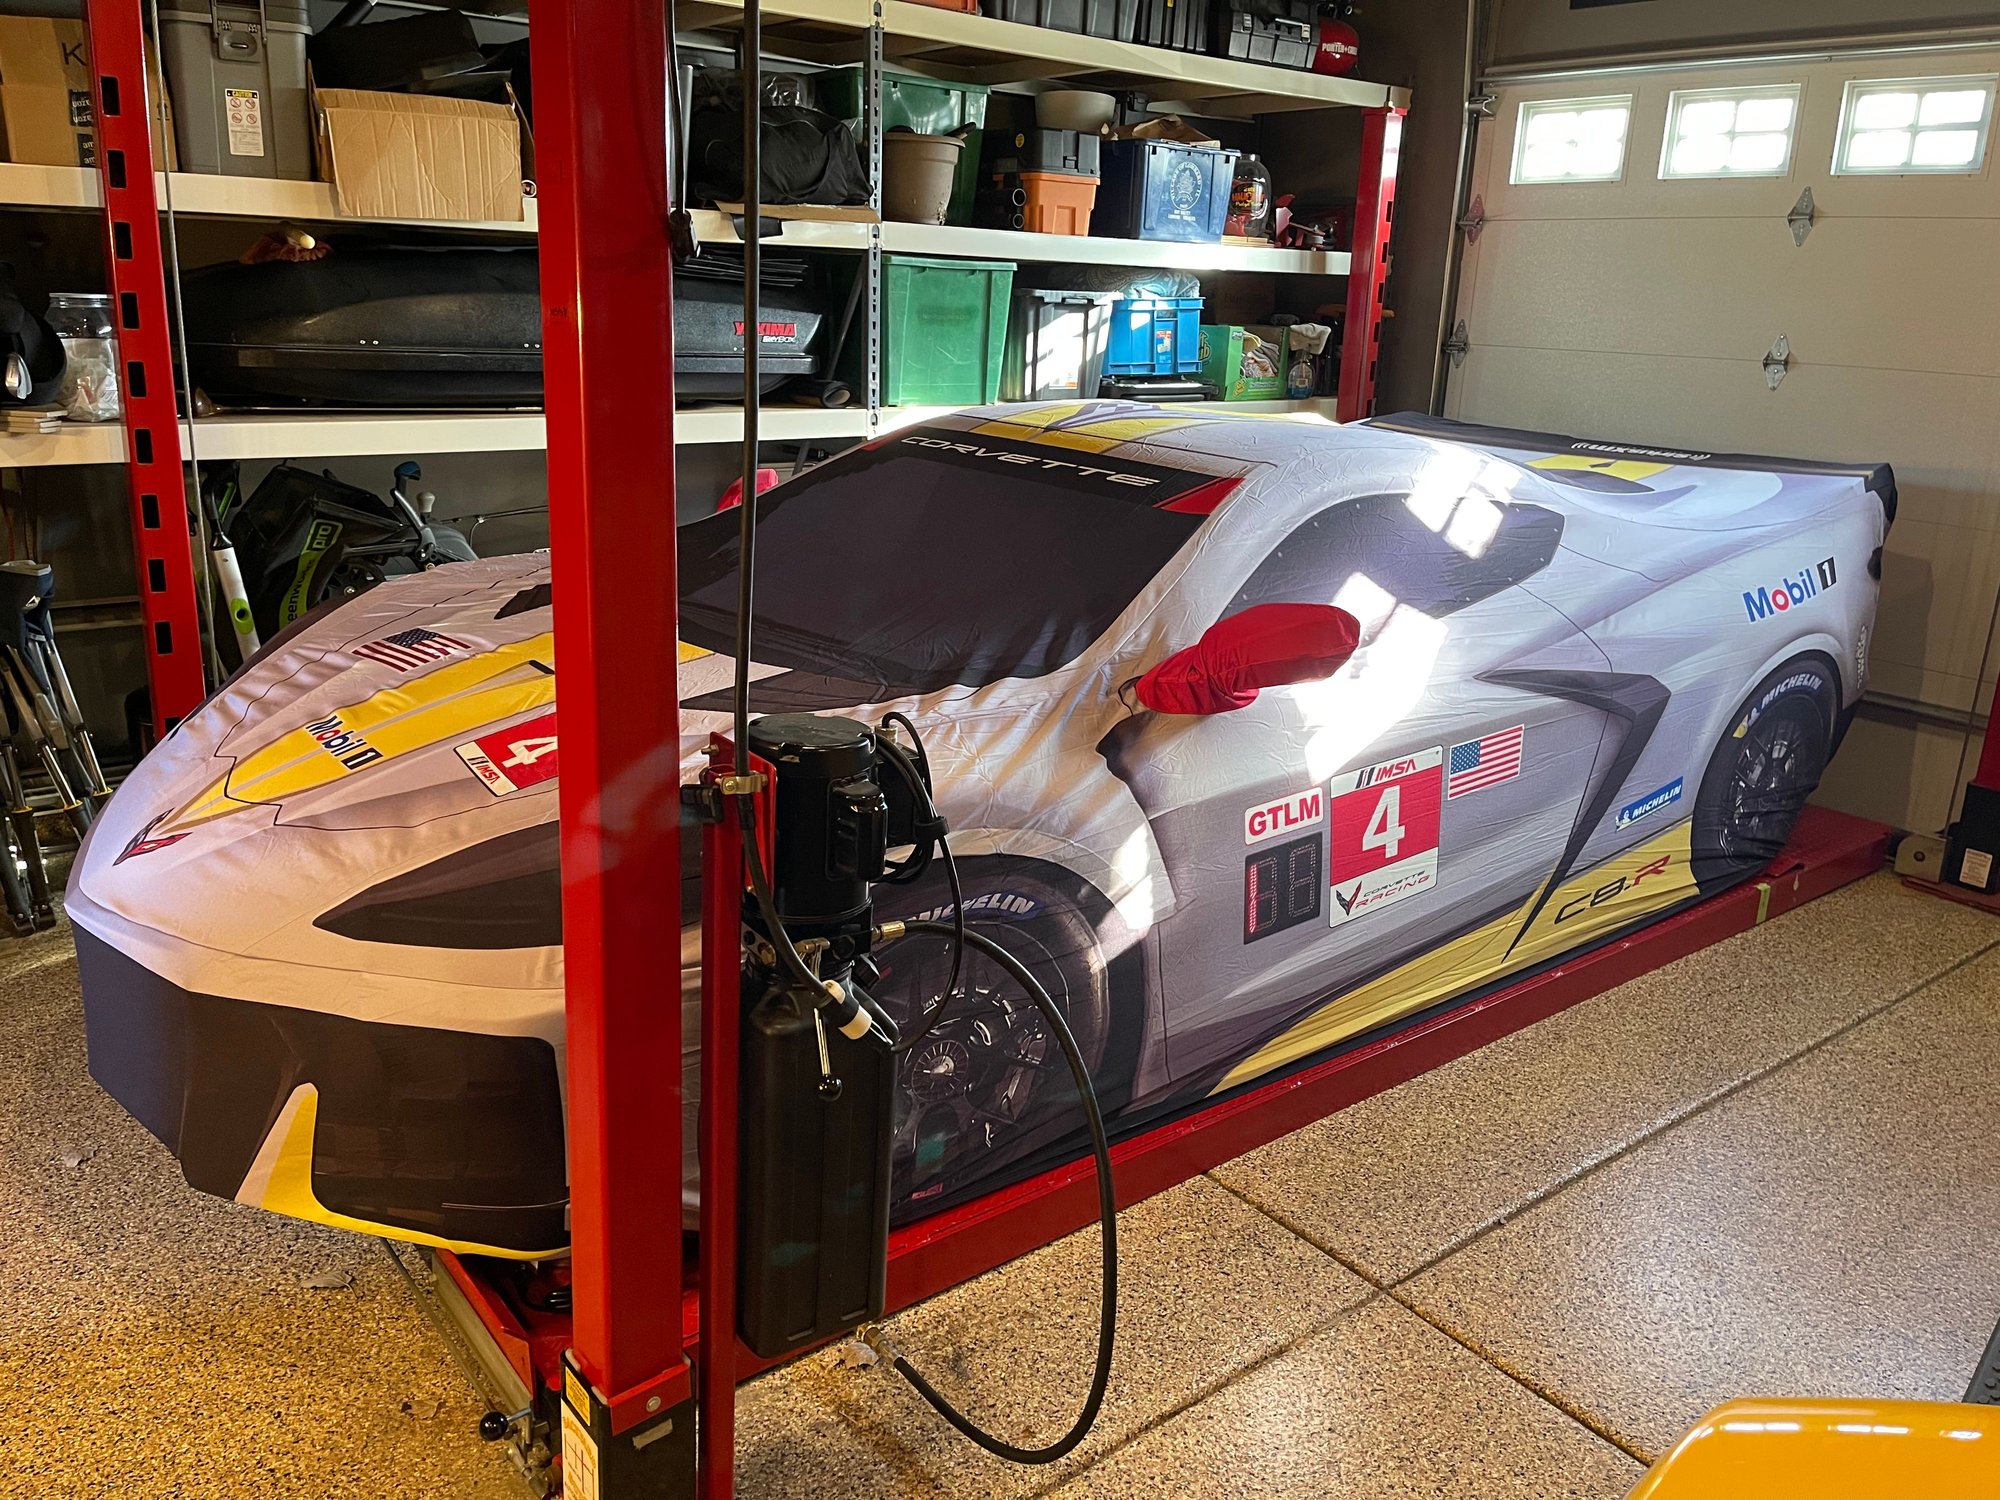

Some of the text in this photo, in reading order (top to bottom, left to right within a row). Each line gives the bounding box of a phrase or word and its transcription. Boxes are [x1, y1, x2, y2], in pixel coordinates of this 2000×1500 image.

[733, 321, 795, 337] YKIMA
[901, 436, 1160, 487] CORVETTE
[312, 525, 332, 549] pro
[287, 559, 314, 622] eenworks
[1742, 568, 1816, 623] Mobil
[1761, 673, 1823, 709] MICHELIN
[305, 715, 364, 757] Mobil
[501, 735, 558, 768] 4
[1374, 759, 1417, 782] IMSA
[1249, 793, 1320, 836] GTLM
[1632, 785, 1681, 819] MICHELIN
[1362, 785, 1405, 859] 4
[1355, 875, 1430, 909] RACING
[1363, 870, 1425, 897] CORVETTE
